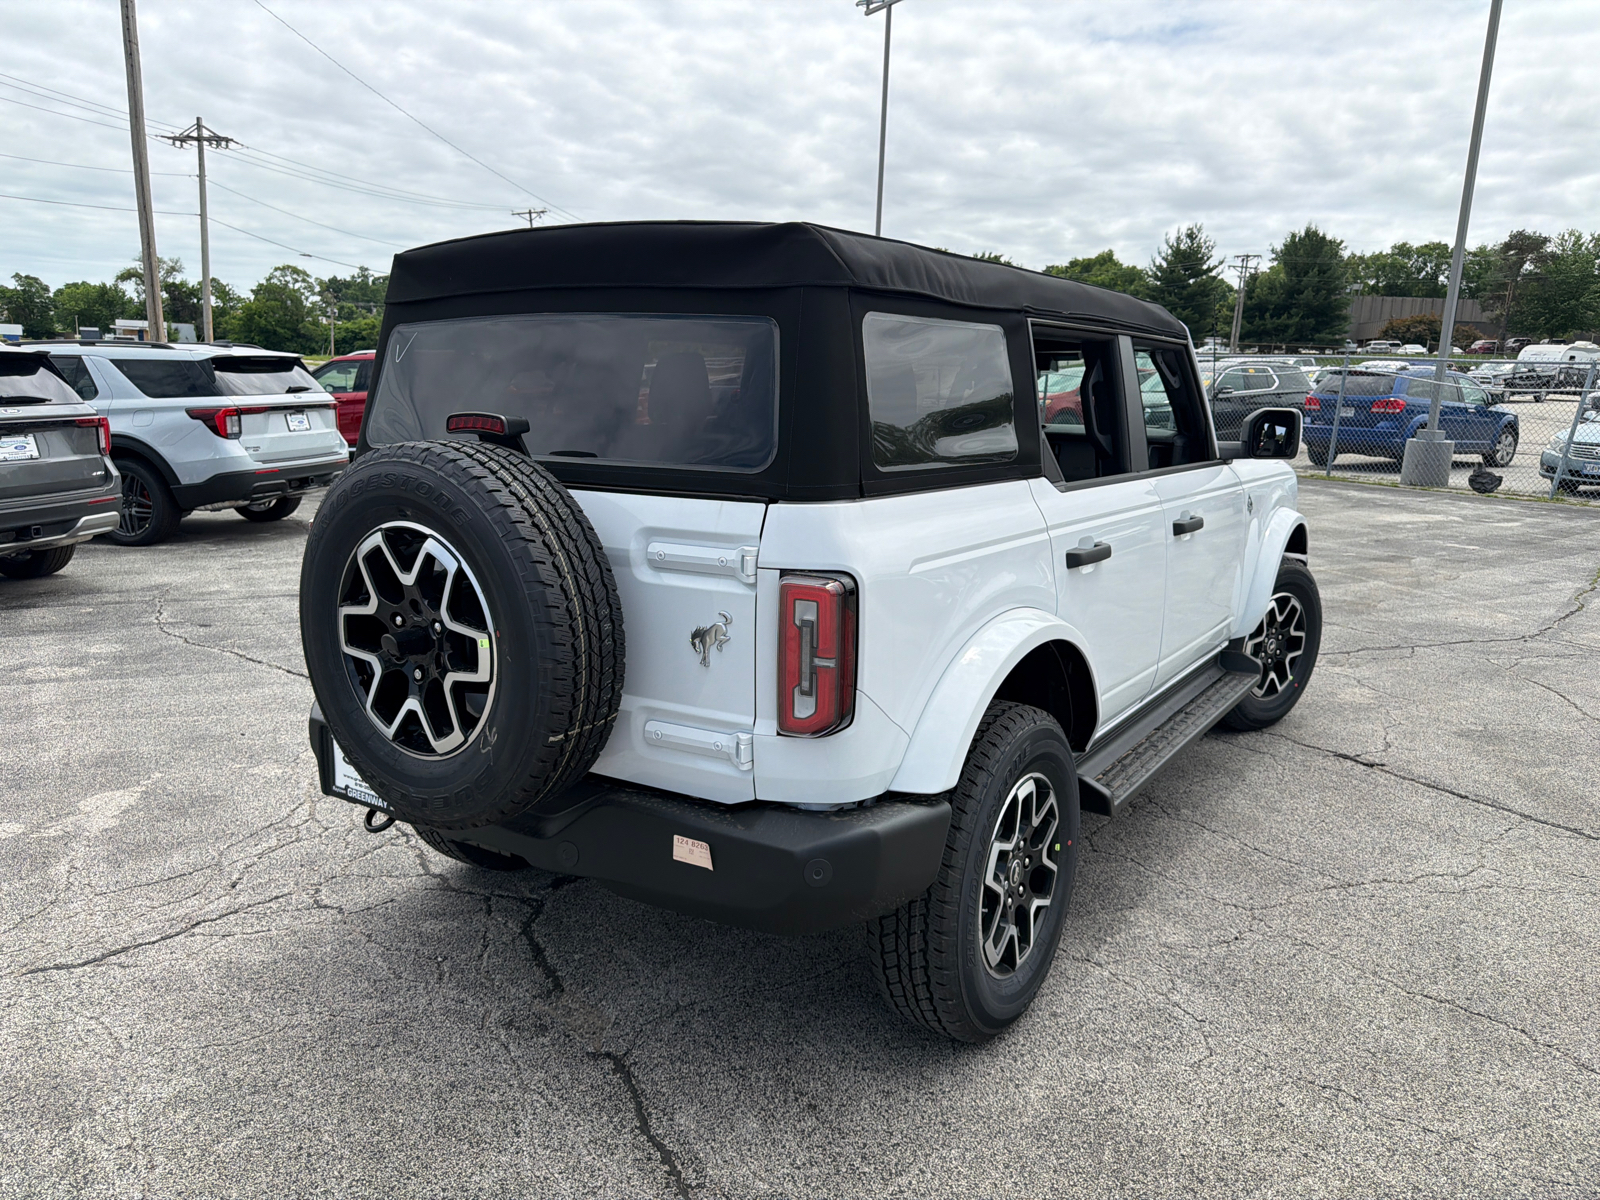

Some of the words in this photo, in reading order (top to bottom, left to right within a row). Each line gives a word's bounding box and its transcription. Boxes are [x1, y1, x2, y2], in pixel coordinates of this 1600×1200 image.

[347, 788, 388, 809] GREENWAY
[676, 837, 689, 845] 124
[691, 841, 709, 851] 8263
